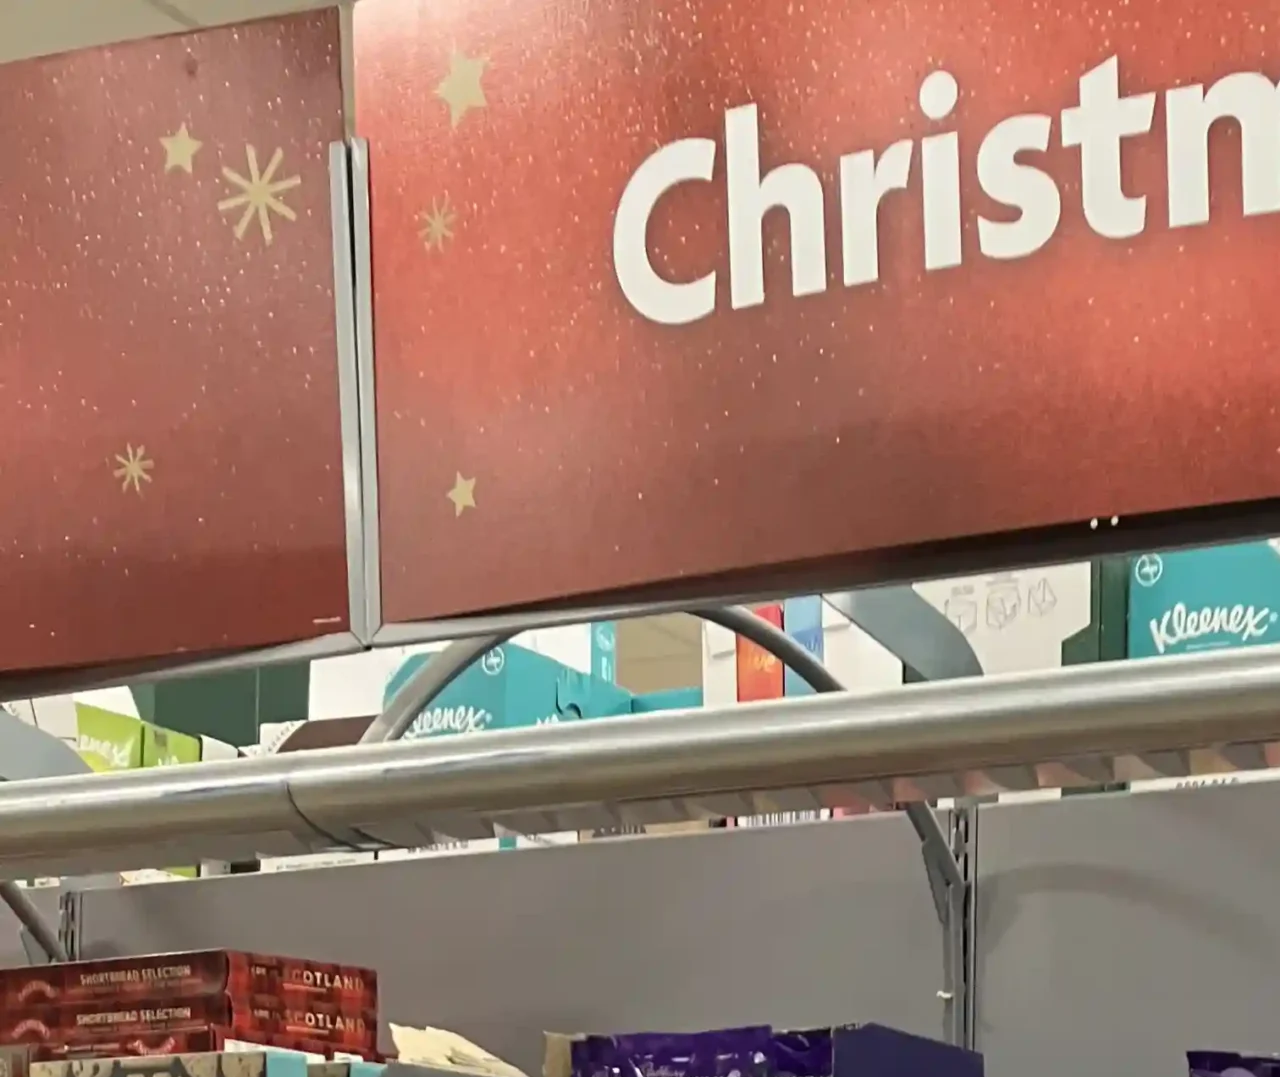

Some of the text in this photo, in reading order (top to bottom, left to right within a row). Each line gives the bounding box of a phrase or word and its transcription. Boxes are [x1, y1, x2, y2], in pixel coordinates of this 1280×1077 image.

[1149, 602, 1270, 654] Kleenex
[142, 965, 191, 982] SELECTION
[140, 1007, 191, 1022] SELECTION
